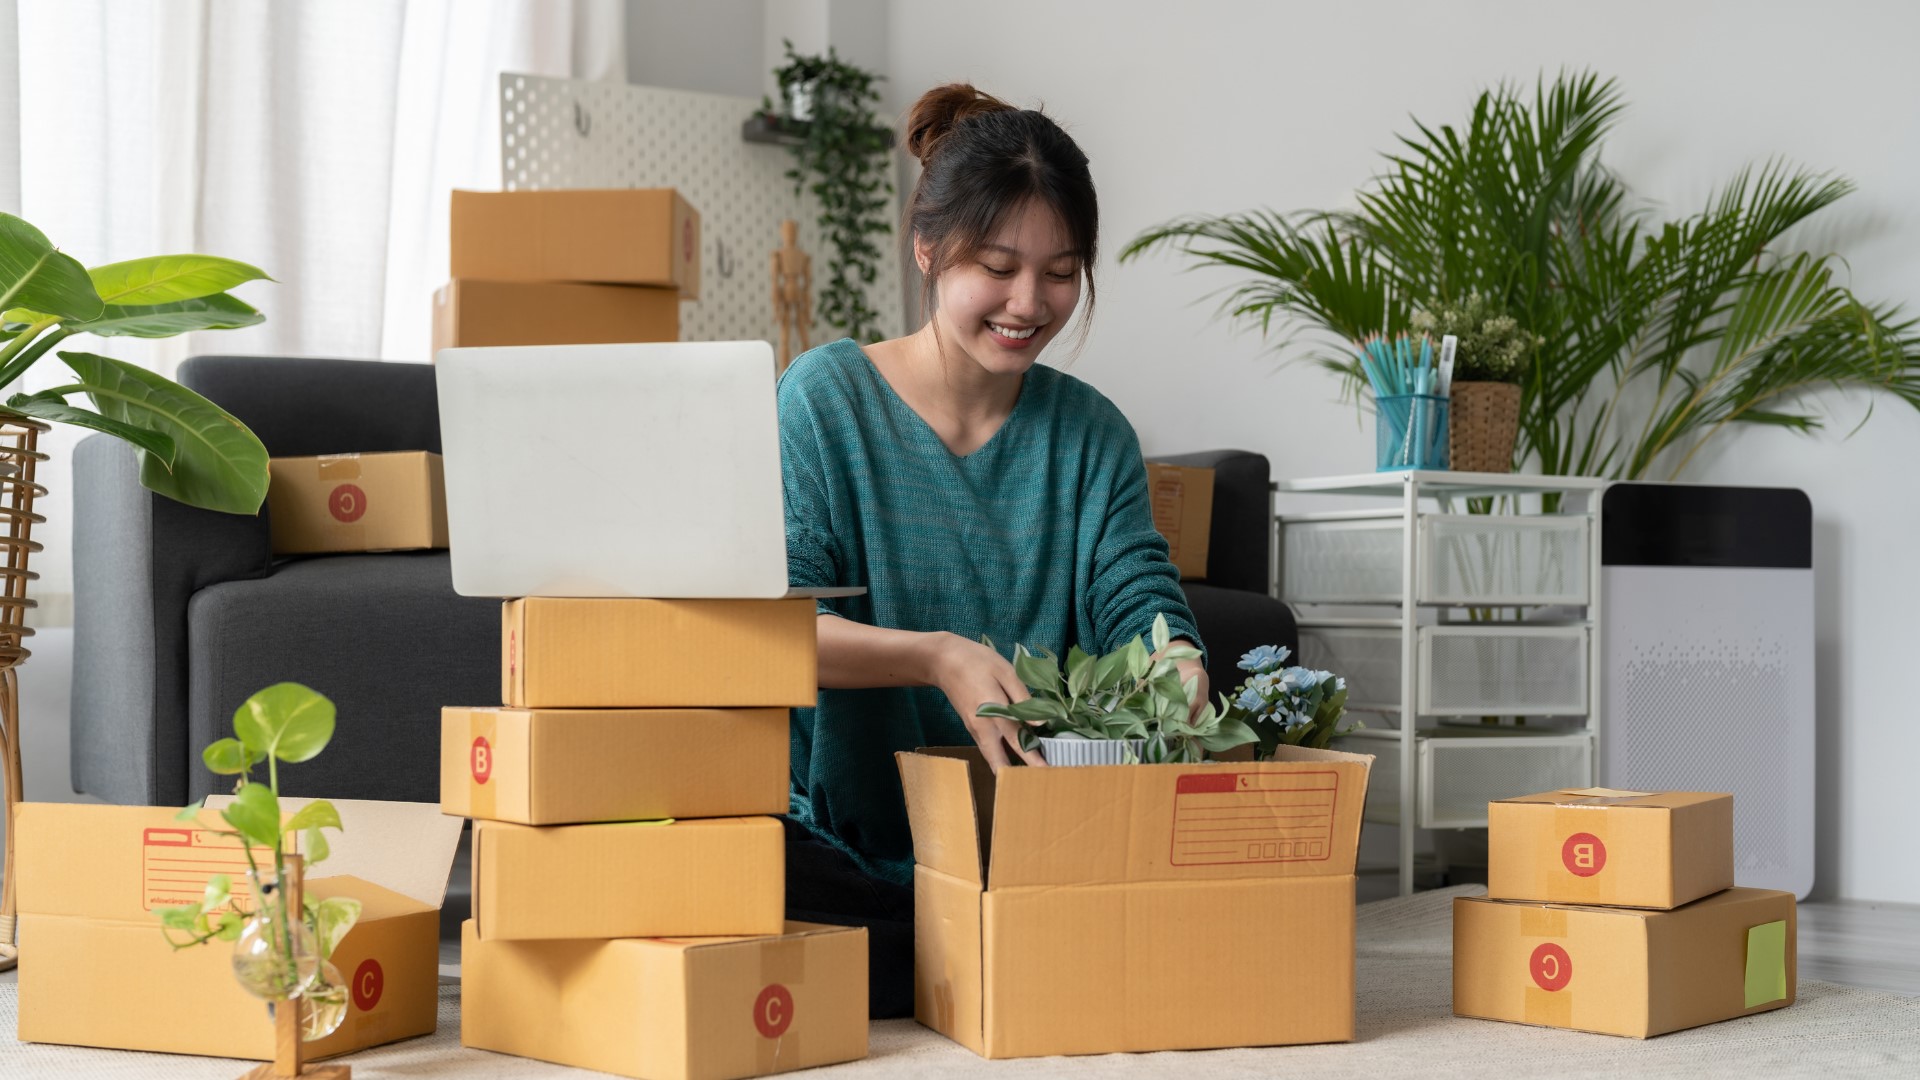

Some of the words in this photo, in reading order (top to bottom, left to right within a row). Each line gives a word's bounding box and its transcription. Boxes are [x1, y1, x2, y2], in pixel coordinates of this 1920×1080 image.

[340, 493, 355, 513] C
[475, 746, 487, 773] B
[1573, 843, 1594, 868] B
[1542, 954, 1559, 980] C
[362, 971, 375, 999] C
[765, 997, 782, 1025] C
